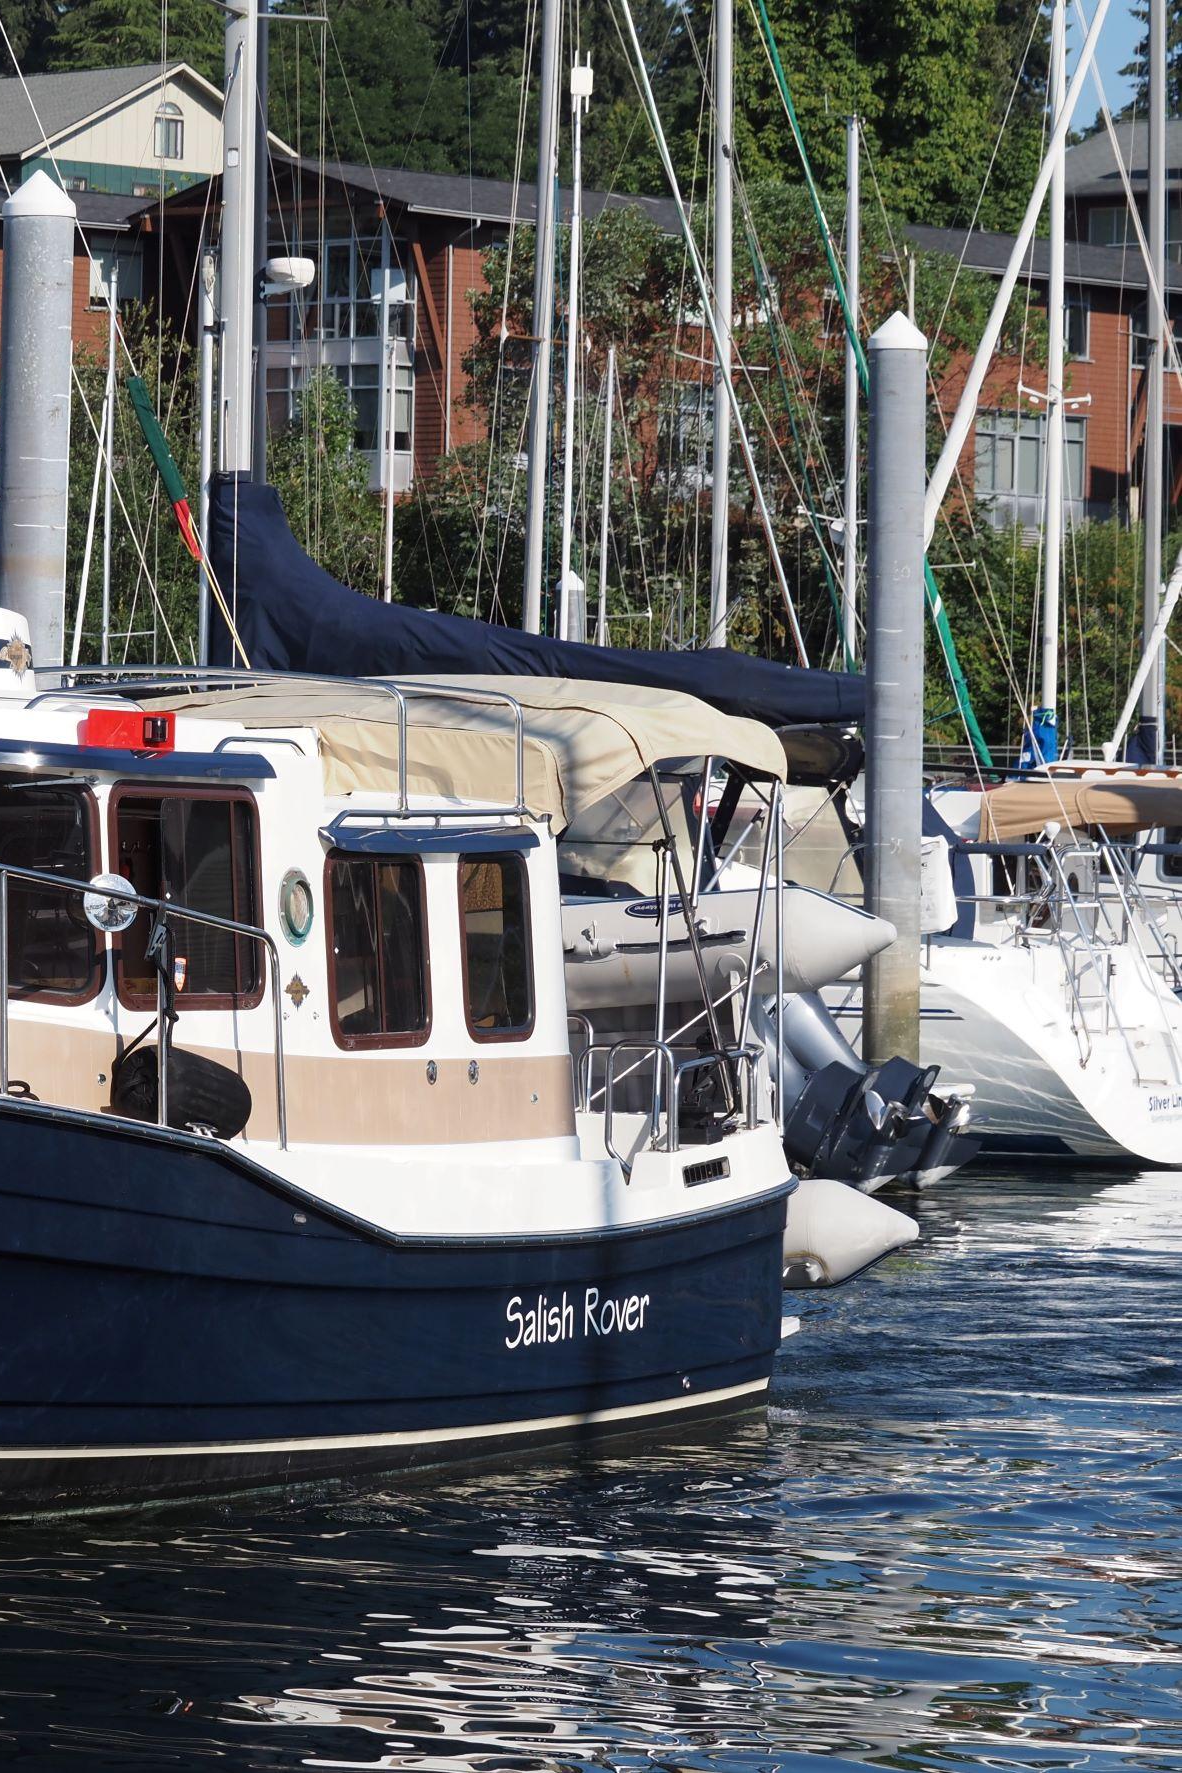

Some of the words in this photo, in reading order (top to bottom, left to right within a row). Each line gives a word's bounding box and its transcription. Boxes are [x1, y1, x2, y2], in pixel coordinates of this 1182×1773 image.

[1149, 1095, 1170, 1111] Silver
[505, 1291, 574, 1349] Salish
[584, 1287, 650, 1337] Rover
